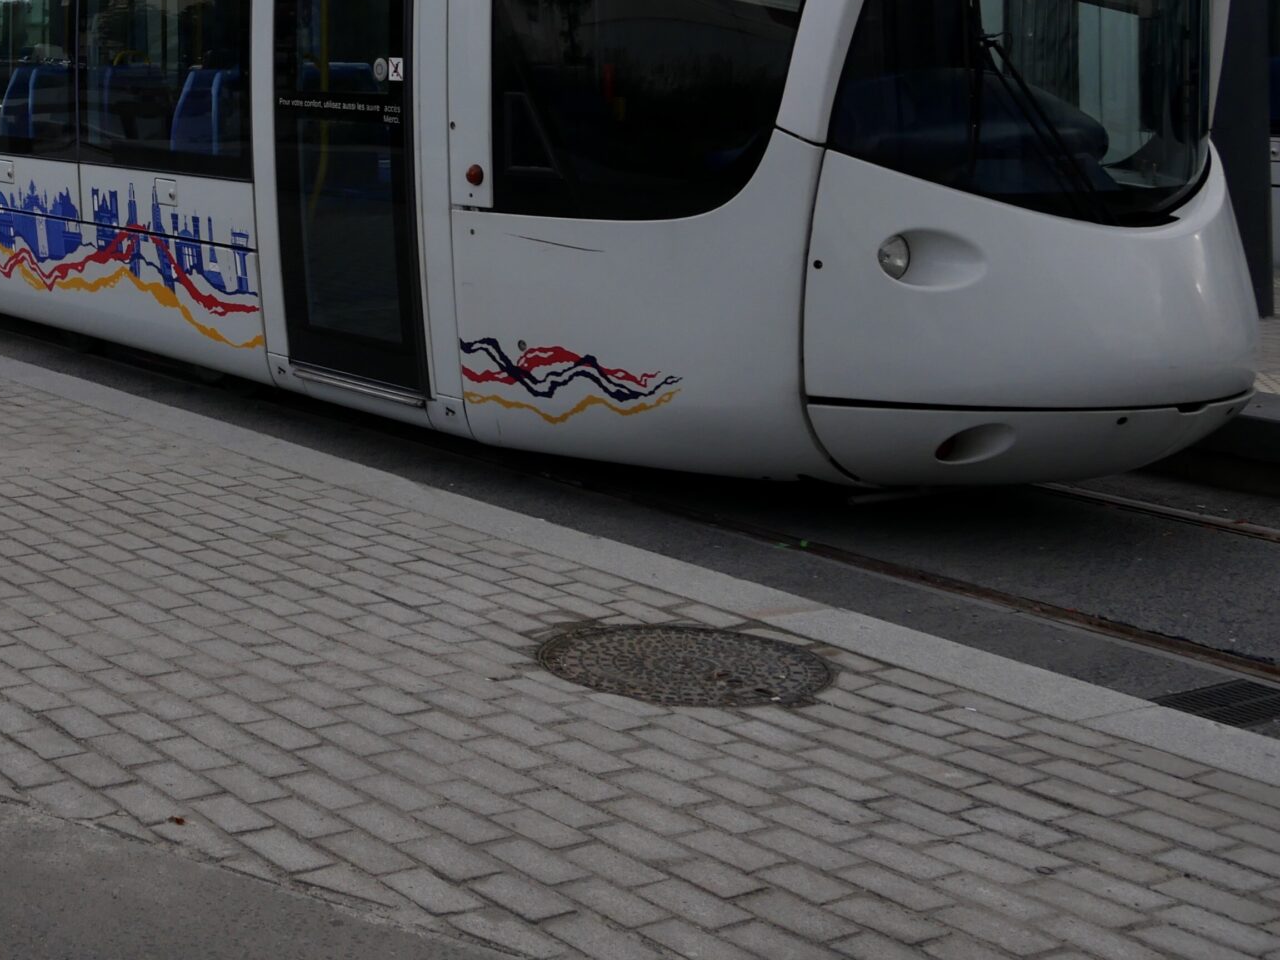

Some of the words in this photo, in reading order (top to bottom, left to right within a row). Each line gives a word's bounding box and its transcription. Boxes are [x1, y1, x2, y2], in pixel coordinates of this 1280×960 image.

[279, 97, 291, 106] Pour
[291, 99, 303, 107] votre
[356, 102, 365, 111] les
